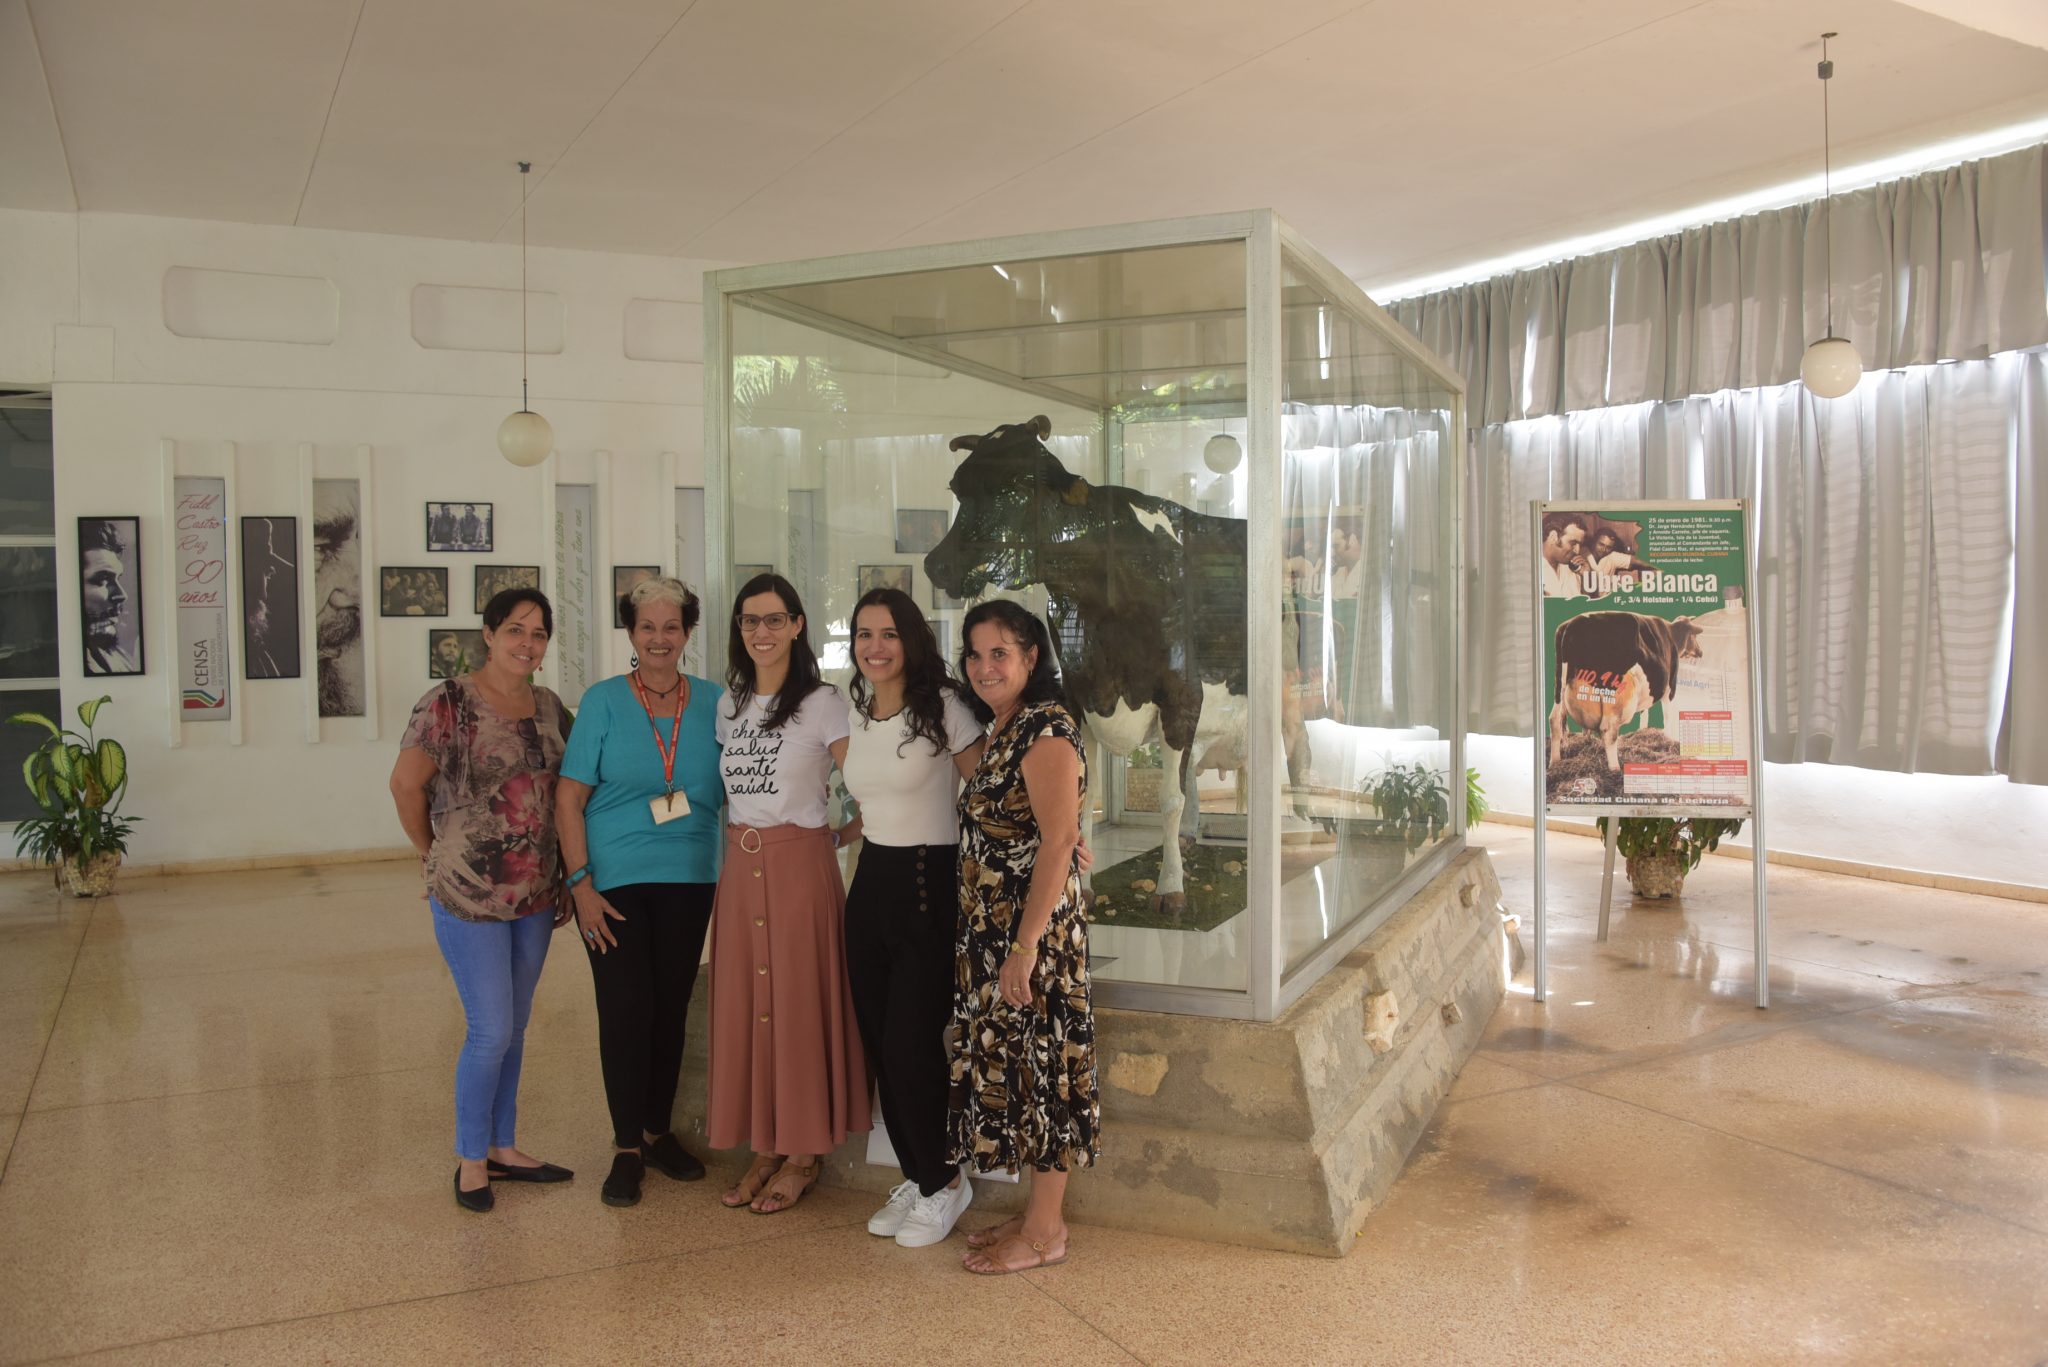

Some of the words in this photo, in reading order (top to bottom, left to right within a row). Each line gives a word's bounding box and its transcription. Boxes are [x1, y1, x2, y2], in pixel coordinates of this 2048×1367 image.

[177, 494, 220, 510] Fidel
[176, 514, 221, 530] Castro
[177, 534, 209, 555] Ruz
[179, 559, 223, 584] 90
[1583, 570, 1634, 593] Ubre
[1642, 570, 1718, 593] Blanca
[178, 590, 218, 603] años
[1643, 596, 1674, 604] Holstein
[1682, 595, 1693, 603] 1/4
[193, 639, 209, 687] CENSA
[1579, 685, 1590, 693] de
[1592, 686, 1616, 696] leche
[732, 719, 782, 739] cheers
[724, 738, 784, 757] salud
[724, 755, 778, 777] santé
[729, 776, 779, 795] saúde
[1560, 796, 1612, 804] Sociedad
[1615, 796, 1658, 804] Cubana
